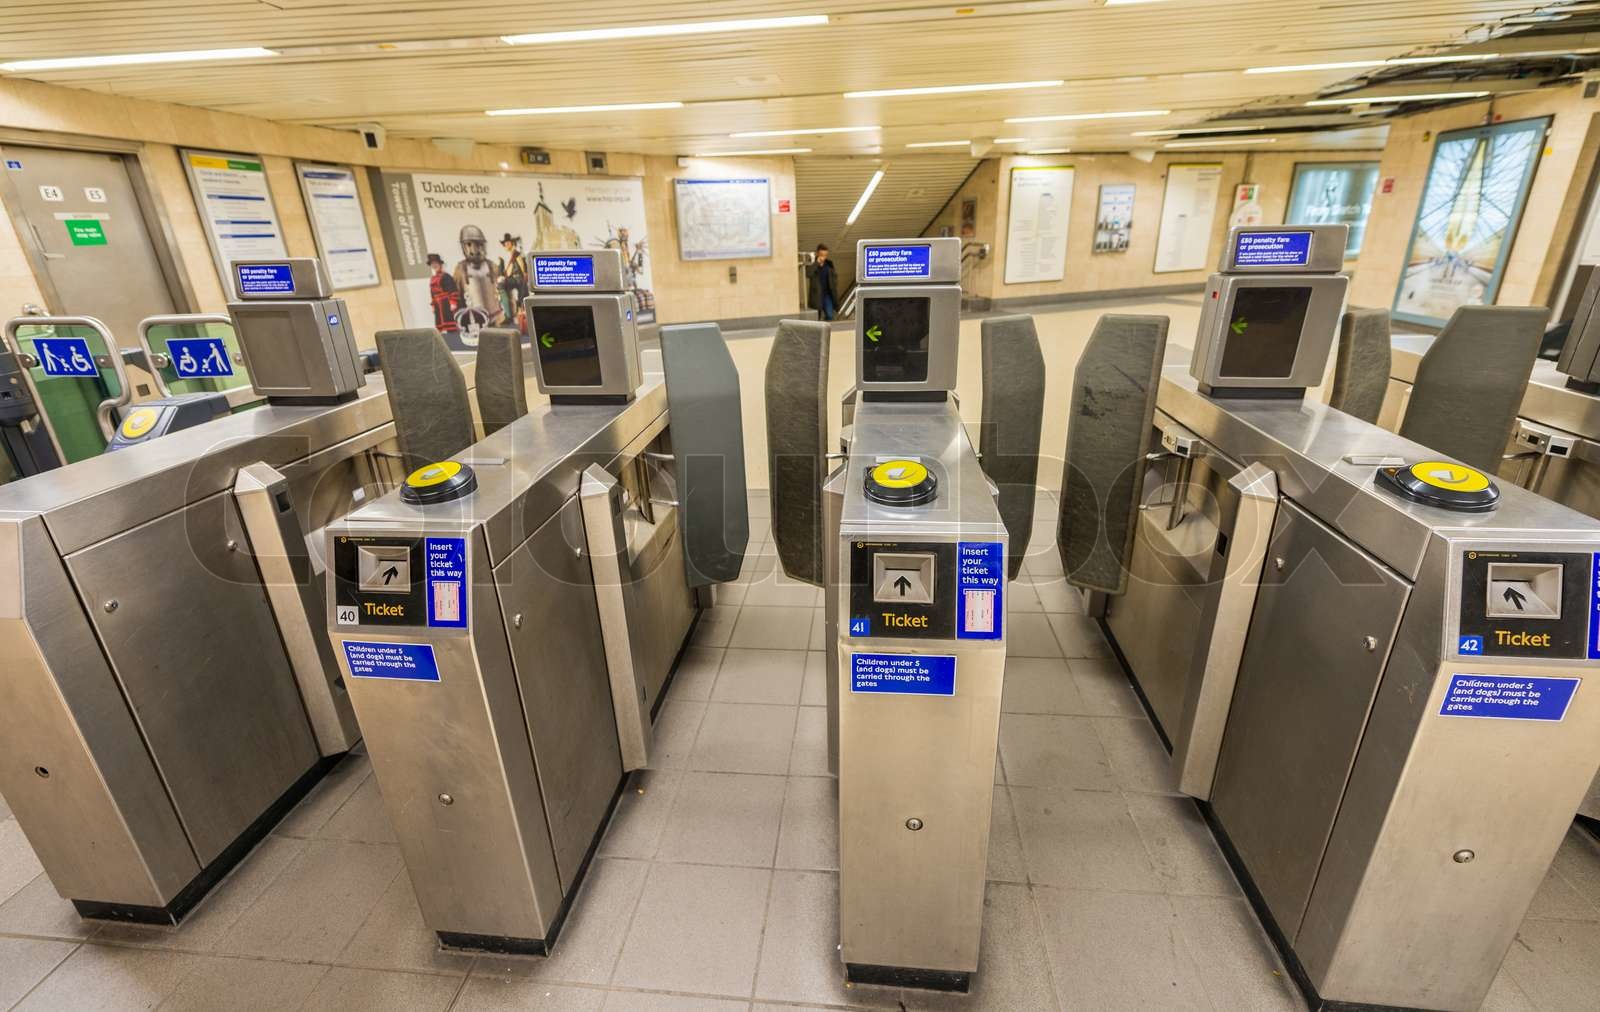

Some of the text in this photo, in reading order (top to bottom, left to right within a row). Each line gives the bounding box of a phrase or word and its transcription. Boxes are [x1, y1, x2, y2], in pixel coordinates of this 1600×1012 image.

[421, 181, 490, 194] Unlock the
[424, 197, 526, 209] Tower of London
[962, 547, 988, 555] Insert
[430, 552, 447, 560] your
[962, 558, 982, 566] your
[431, 569, 462, 578] this way
[962, 566, 988, 574] ticket
[962, 576, 999, 586] this way
[364, 602, 405, 617] Ticket
[340, 610, 355, 622] 40
[882, 612, 929, 628] Ticket
[851, 622, 864, 633] 41
[1495, 630, 1551, 647] Ticket
[348, 645, 376, 653] Children
[1461, 639, 1478, 651] 42
[856, 658, 888, 666] Children
[875, 666, 895, 674] dogs)
[884, 673, 914, 682] through
[1456, 679, 1495, 688] Children
[1497, 681, 1524, 689] under
[1453, 687, 1474, 695] (and
[1475, 688, 1501, 696] dogs)
[1528, 690, 1541, 698] be
[1484, 697, 1520, 706] through
[1522, 698, 1540, 706] the
[1447, 703, 1473, 711] gates
